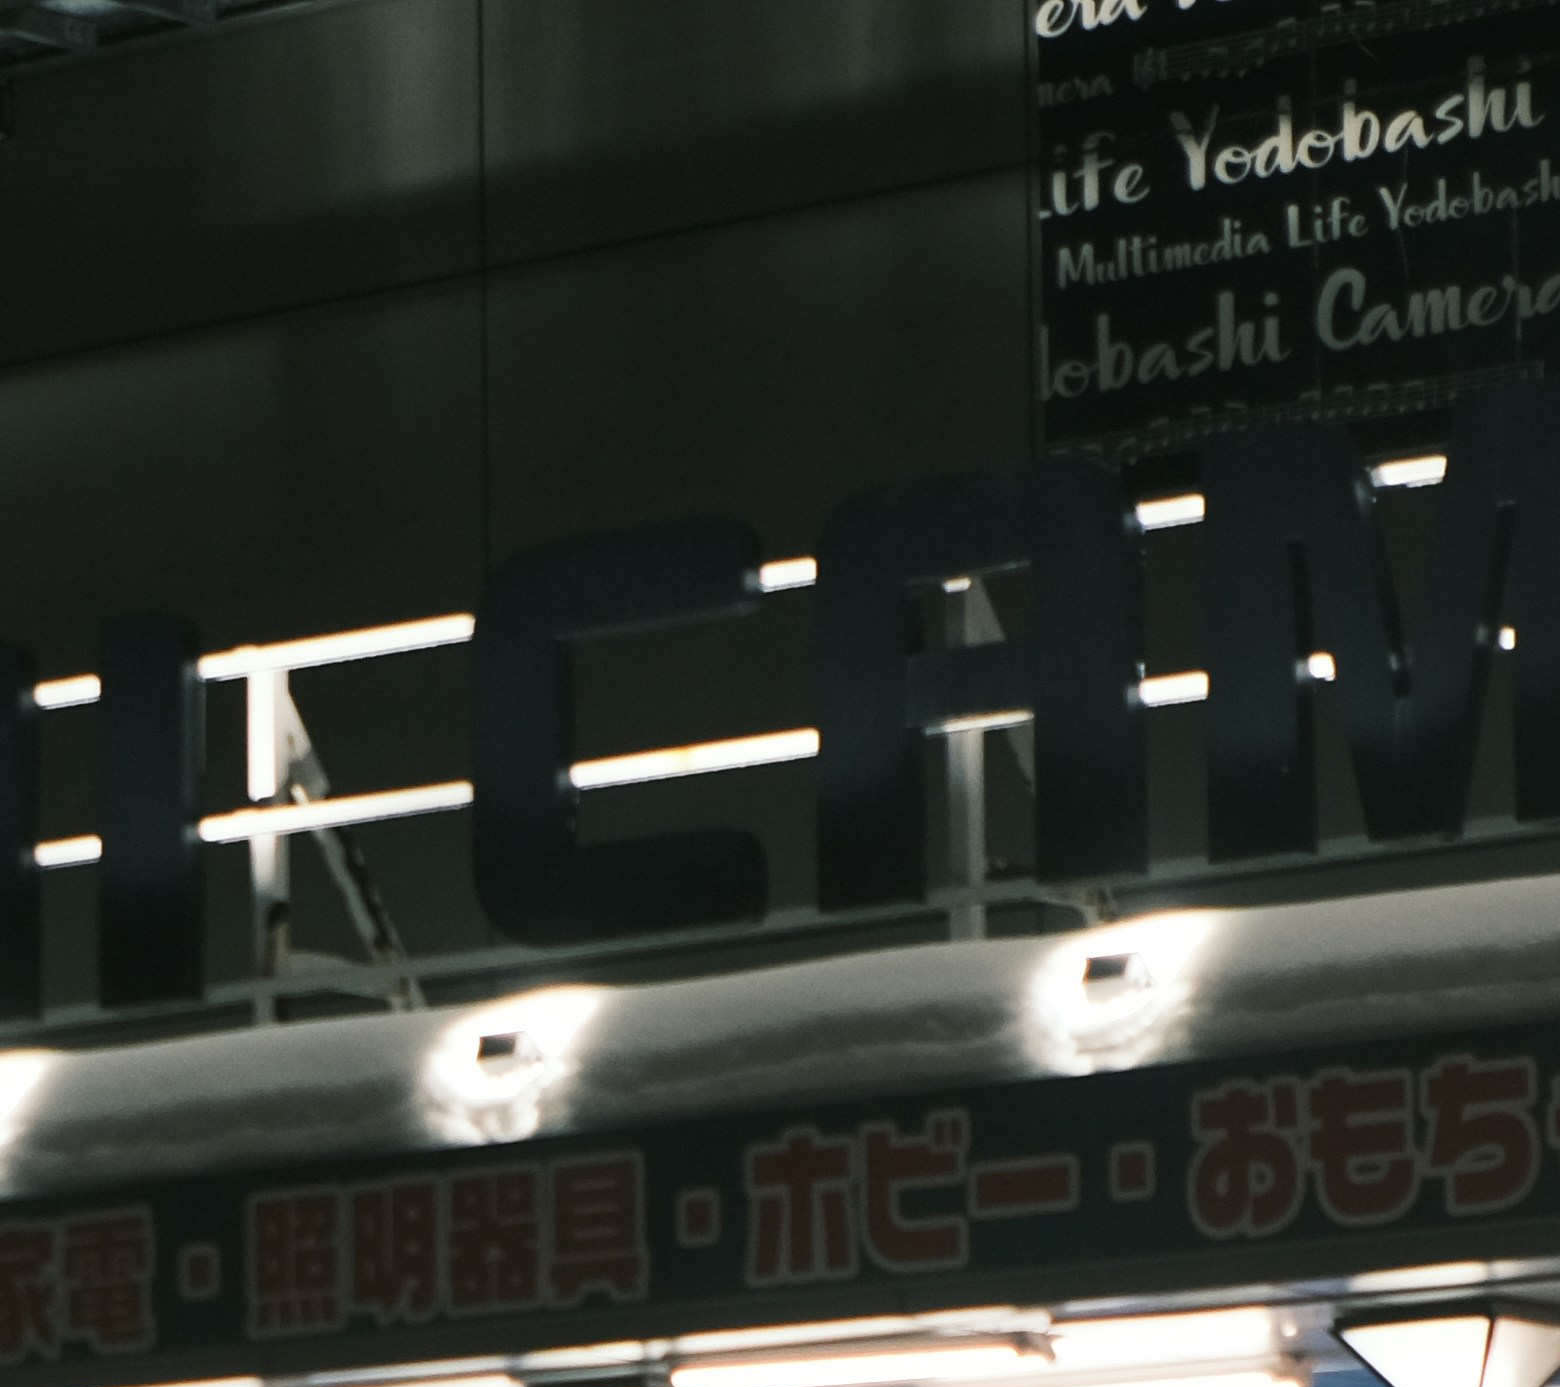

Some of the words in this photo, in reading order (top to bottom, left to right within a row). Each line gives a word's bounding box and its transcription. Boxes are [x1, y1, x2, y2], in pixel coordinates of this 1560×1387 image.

[1038, 130, 1151, 219] ife
[1170, 55, 1544, 191] Yodobashi
[1057, 217, 1273, 290] Multimedia
[1286, 196, 1369, 248] Life
